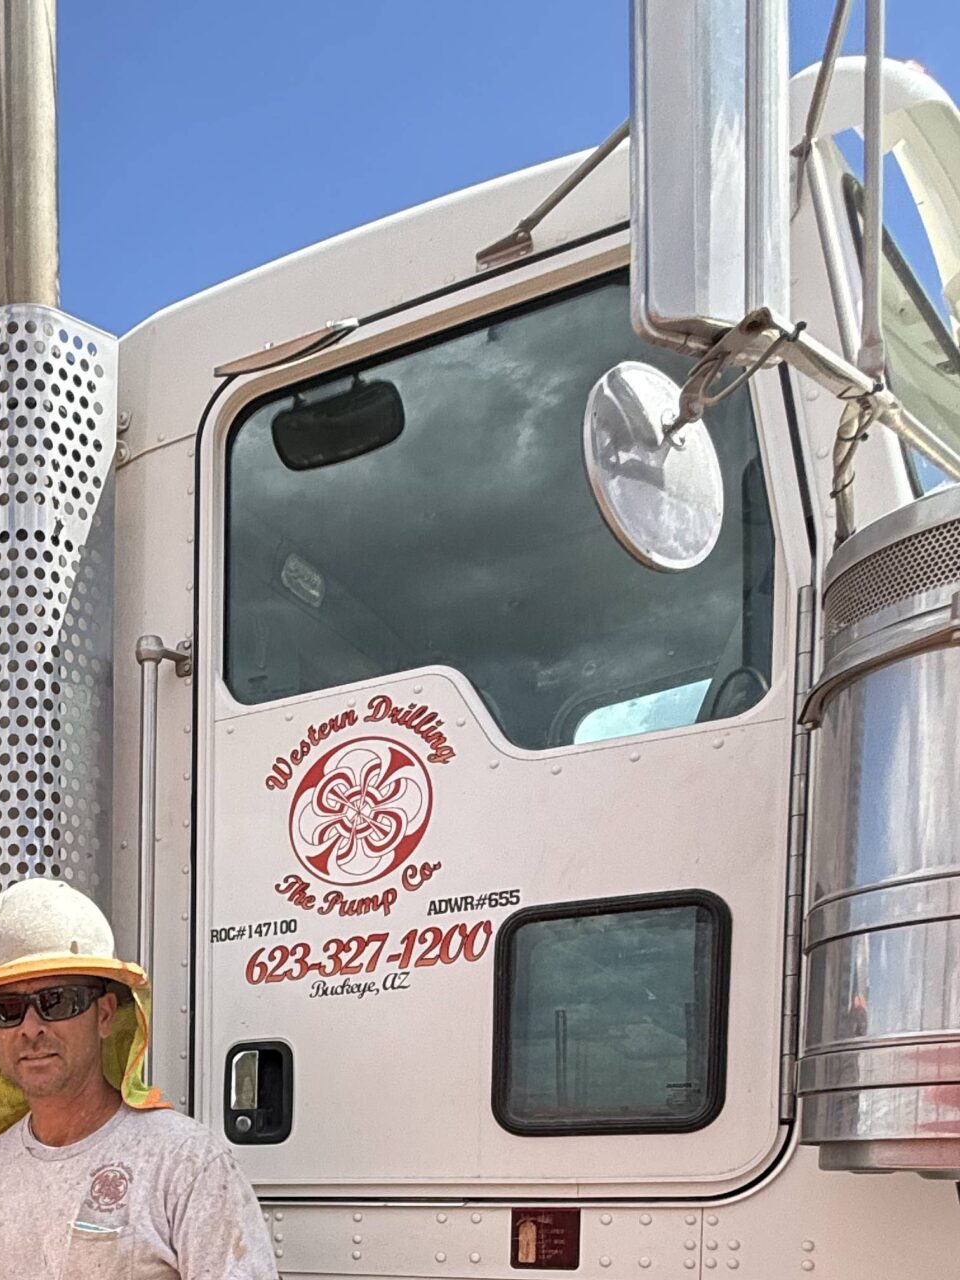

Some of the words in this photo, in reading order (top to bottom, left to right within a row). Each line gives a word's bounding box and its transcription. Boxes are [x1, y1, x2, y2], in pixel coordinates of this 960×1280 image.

[265, 709, 358, 791] Western
[363, 695, 456, 764] Drilling
[274, 874, 316, 910] The
[317, 887, 398, 917] Pump
[427, 889, 521, 916] ADWR#655
[210, 919, 298, 944] ROC#147100
[245, 920, 493, 986] 623-327-1200
[309, 978, 380, 999] Buckeye,
[382, 972, 411, 991] AZ
